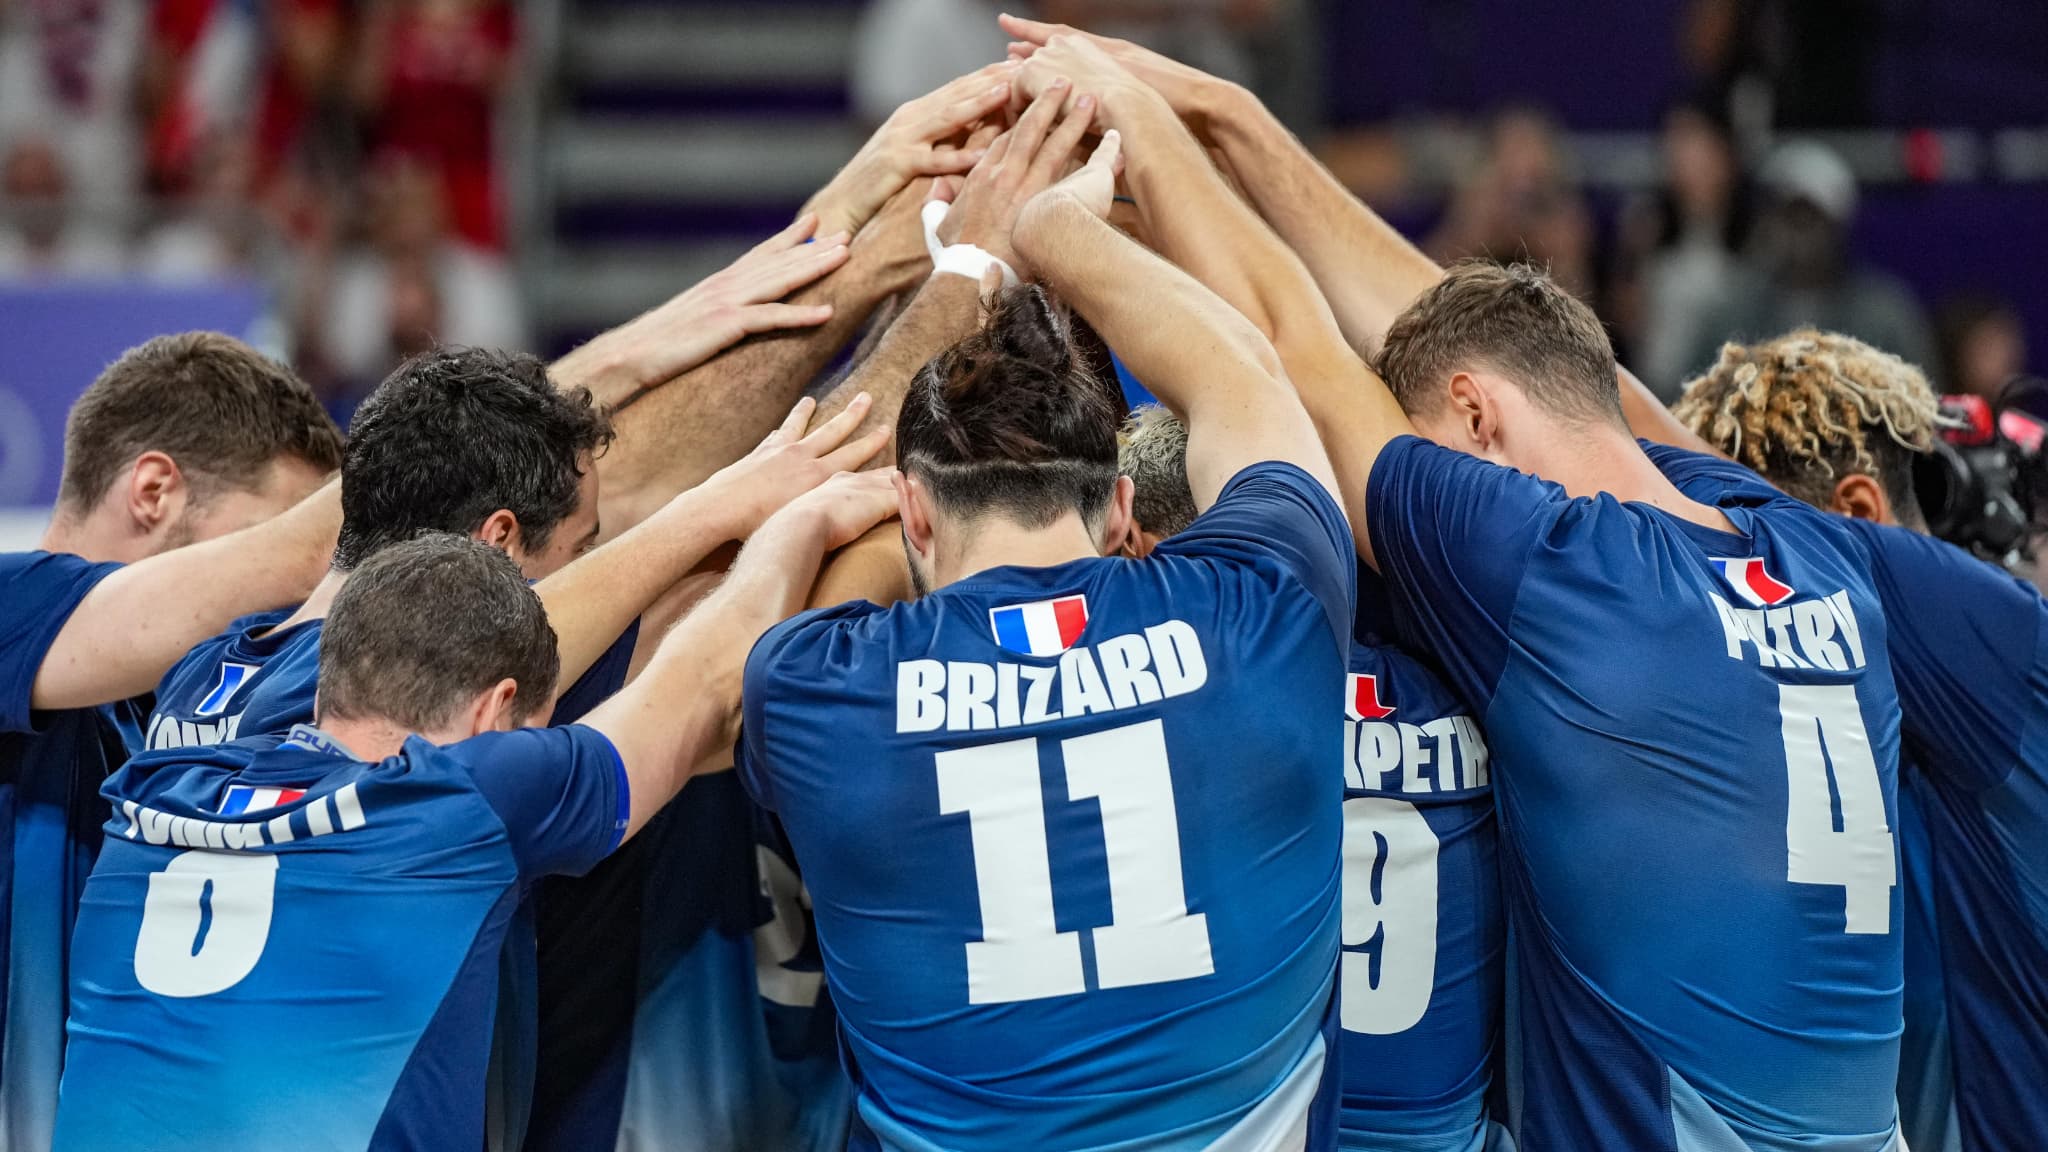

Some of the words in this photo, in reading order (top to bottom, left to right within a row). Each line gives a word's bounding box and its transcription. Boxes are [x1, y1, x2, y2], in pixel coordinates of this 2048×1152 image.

[896, 619, 1208, 733] BRIZARD
[934, 718, 1215, 1005] 11
[1340, 797, 1439, 1035] 9
[1778, 683, 1896, 934] 4
